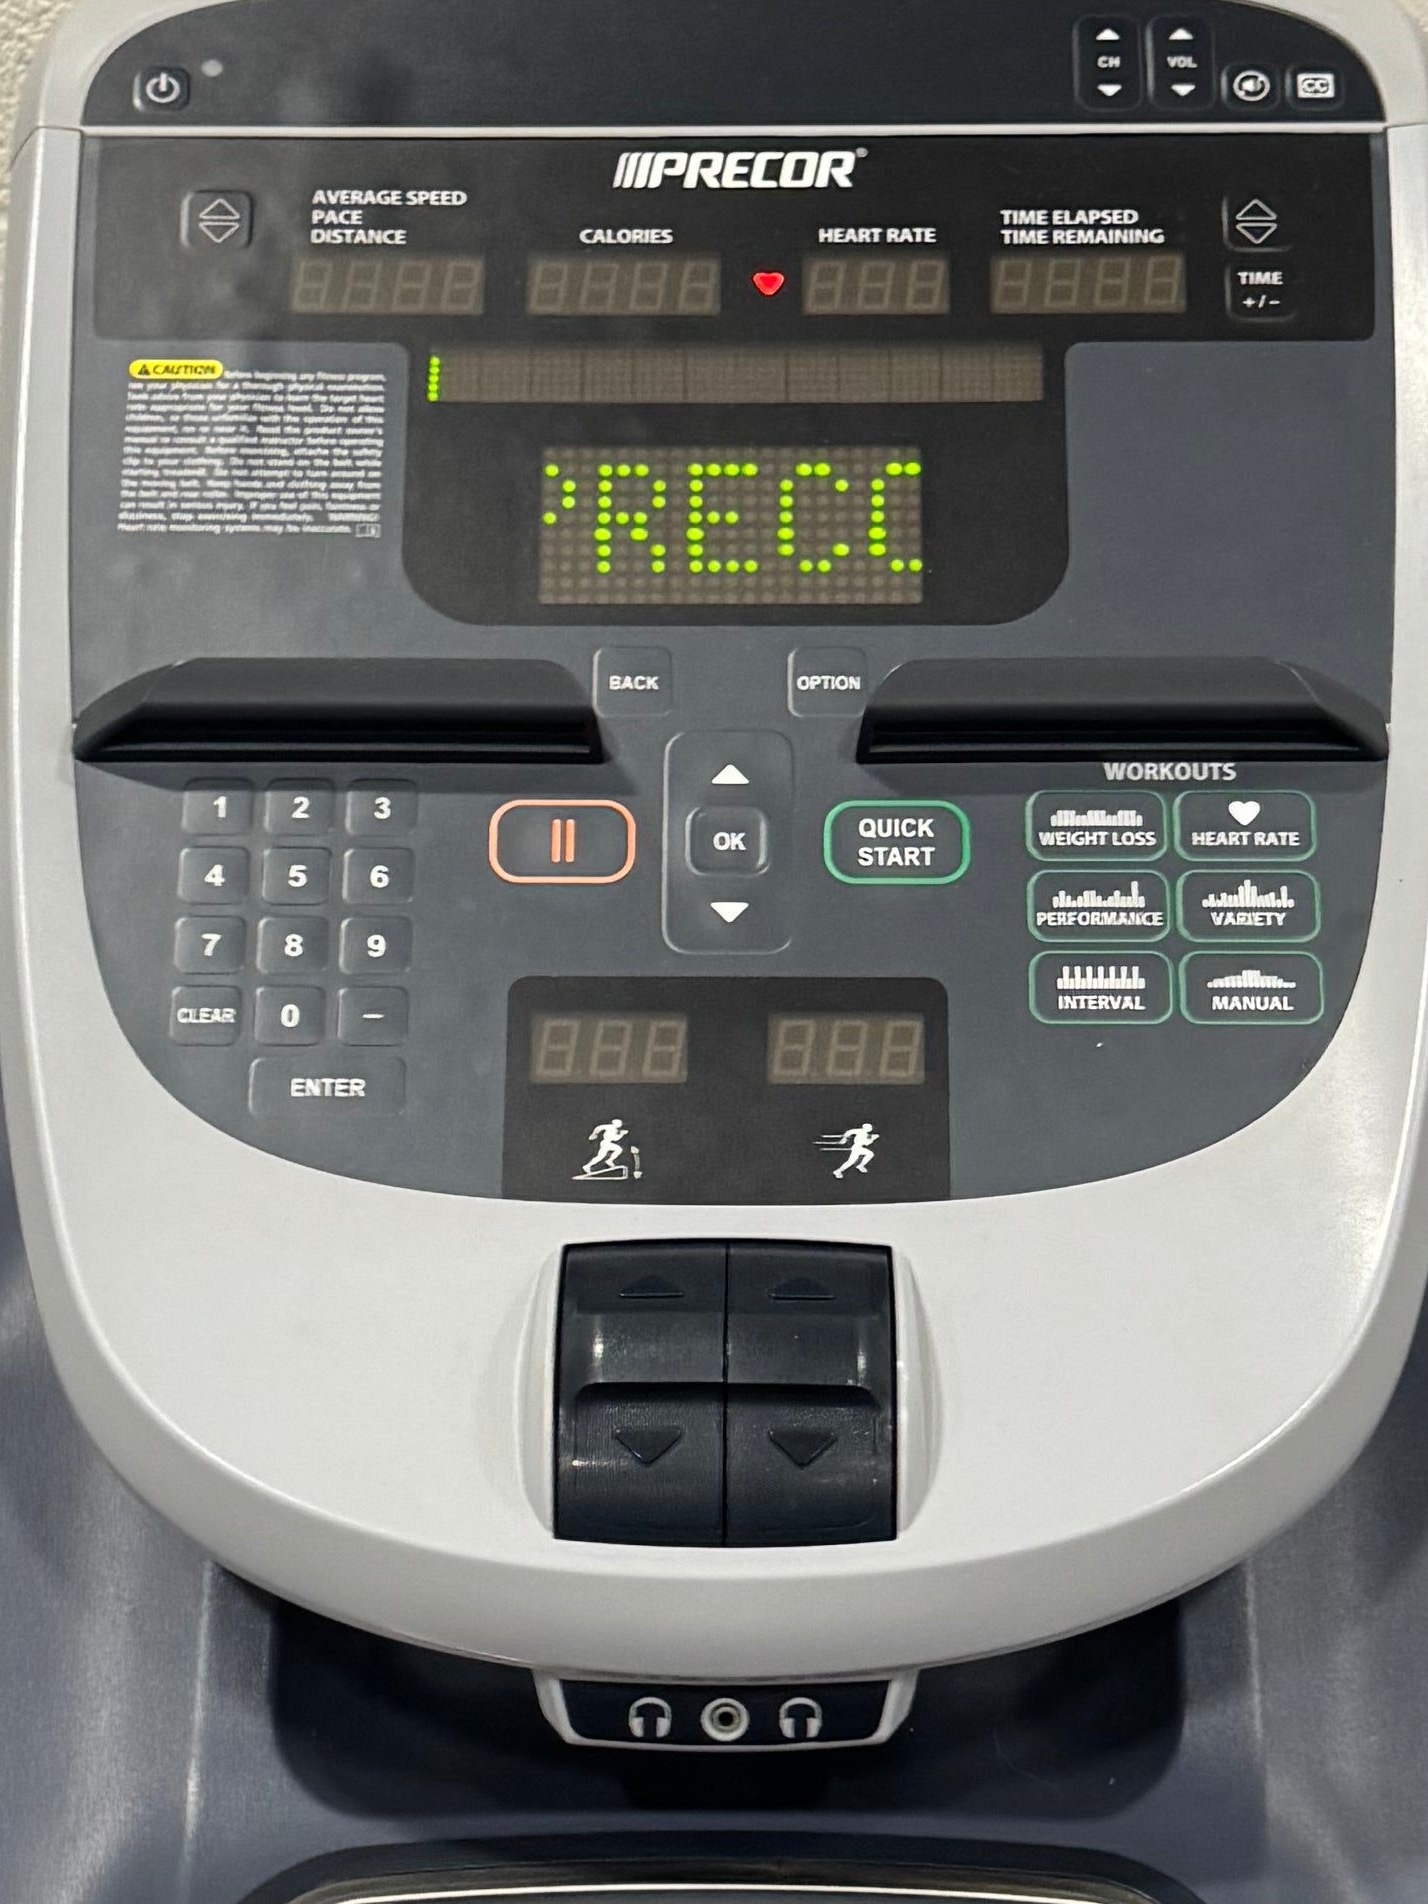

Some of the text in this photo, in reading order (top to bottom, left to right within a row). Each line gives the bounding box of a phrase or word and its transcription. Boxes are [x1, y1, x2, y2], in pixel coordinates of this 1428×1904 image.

[1097, 55, 1121, 69] CH
[1166, 55, 1198, 69] VOL
[311, 189, 468, 206] AVERAGE SPEED
[311, 209, 363, 225] PACE
[999, 208, 1140, 226] TIME ELAPSED
[310, 228, 407, 245] DISTANCE
[579, 228, 674, 244] CALORIES
[818, 227, 937, 243] HEART RATE
[999, 228, 1165, 245] TIME REMAINING
[1237, 271, 1284, 285] TIME
[152, 363, 217, 376] CAUTION
[609, 675, 659, 691] BACK
[796, 675, 861, 691] OPTION
[1101, 761, 1237, 781] WORKOUTS
[212, 795, 227, 818] 1
[291, 796, 310, 819] 2
[373, 796, 391, 820] 3
[858, 817, 935, 839] QUICK
[712, 831, 747, 851] OK
[1038, 831, 1158, 847] WEIGHT LOSS
[1191, 831, 1301, 847] HEART RATE
[857, 846, 936, 867] START
[203, 864, 226, 887] 4
[287, 864, 308, 888] 5
[369, 864, 390, 889] 6
[1035, 911, 1164, 928] PERFORMANCE
[1210, 911, 1287, 927] VARIETY
[201, 933, 222, 957] 7
[284, 933, 304, 957] 8
[366, 934, 387, 958] 9
[1058, 994, 1146, 1011] INTERVAL
[1211, 995, 1295, 1011] MANUAL
[176, 1007, 237, 1024] CLEAR
[280, 1003, 300, 1028] 0
[290, 1077, 366, 1098] ENTER
